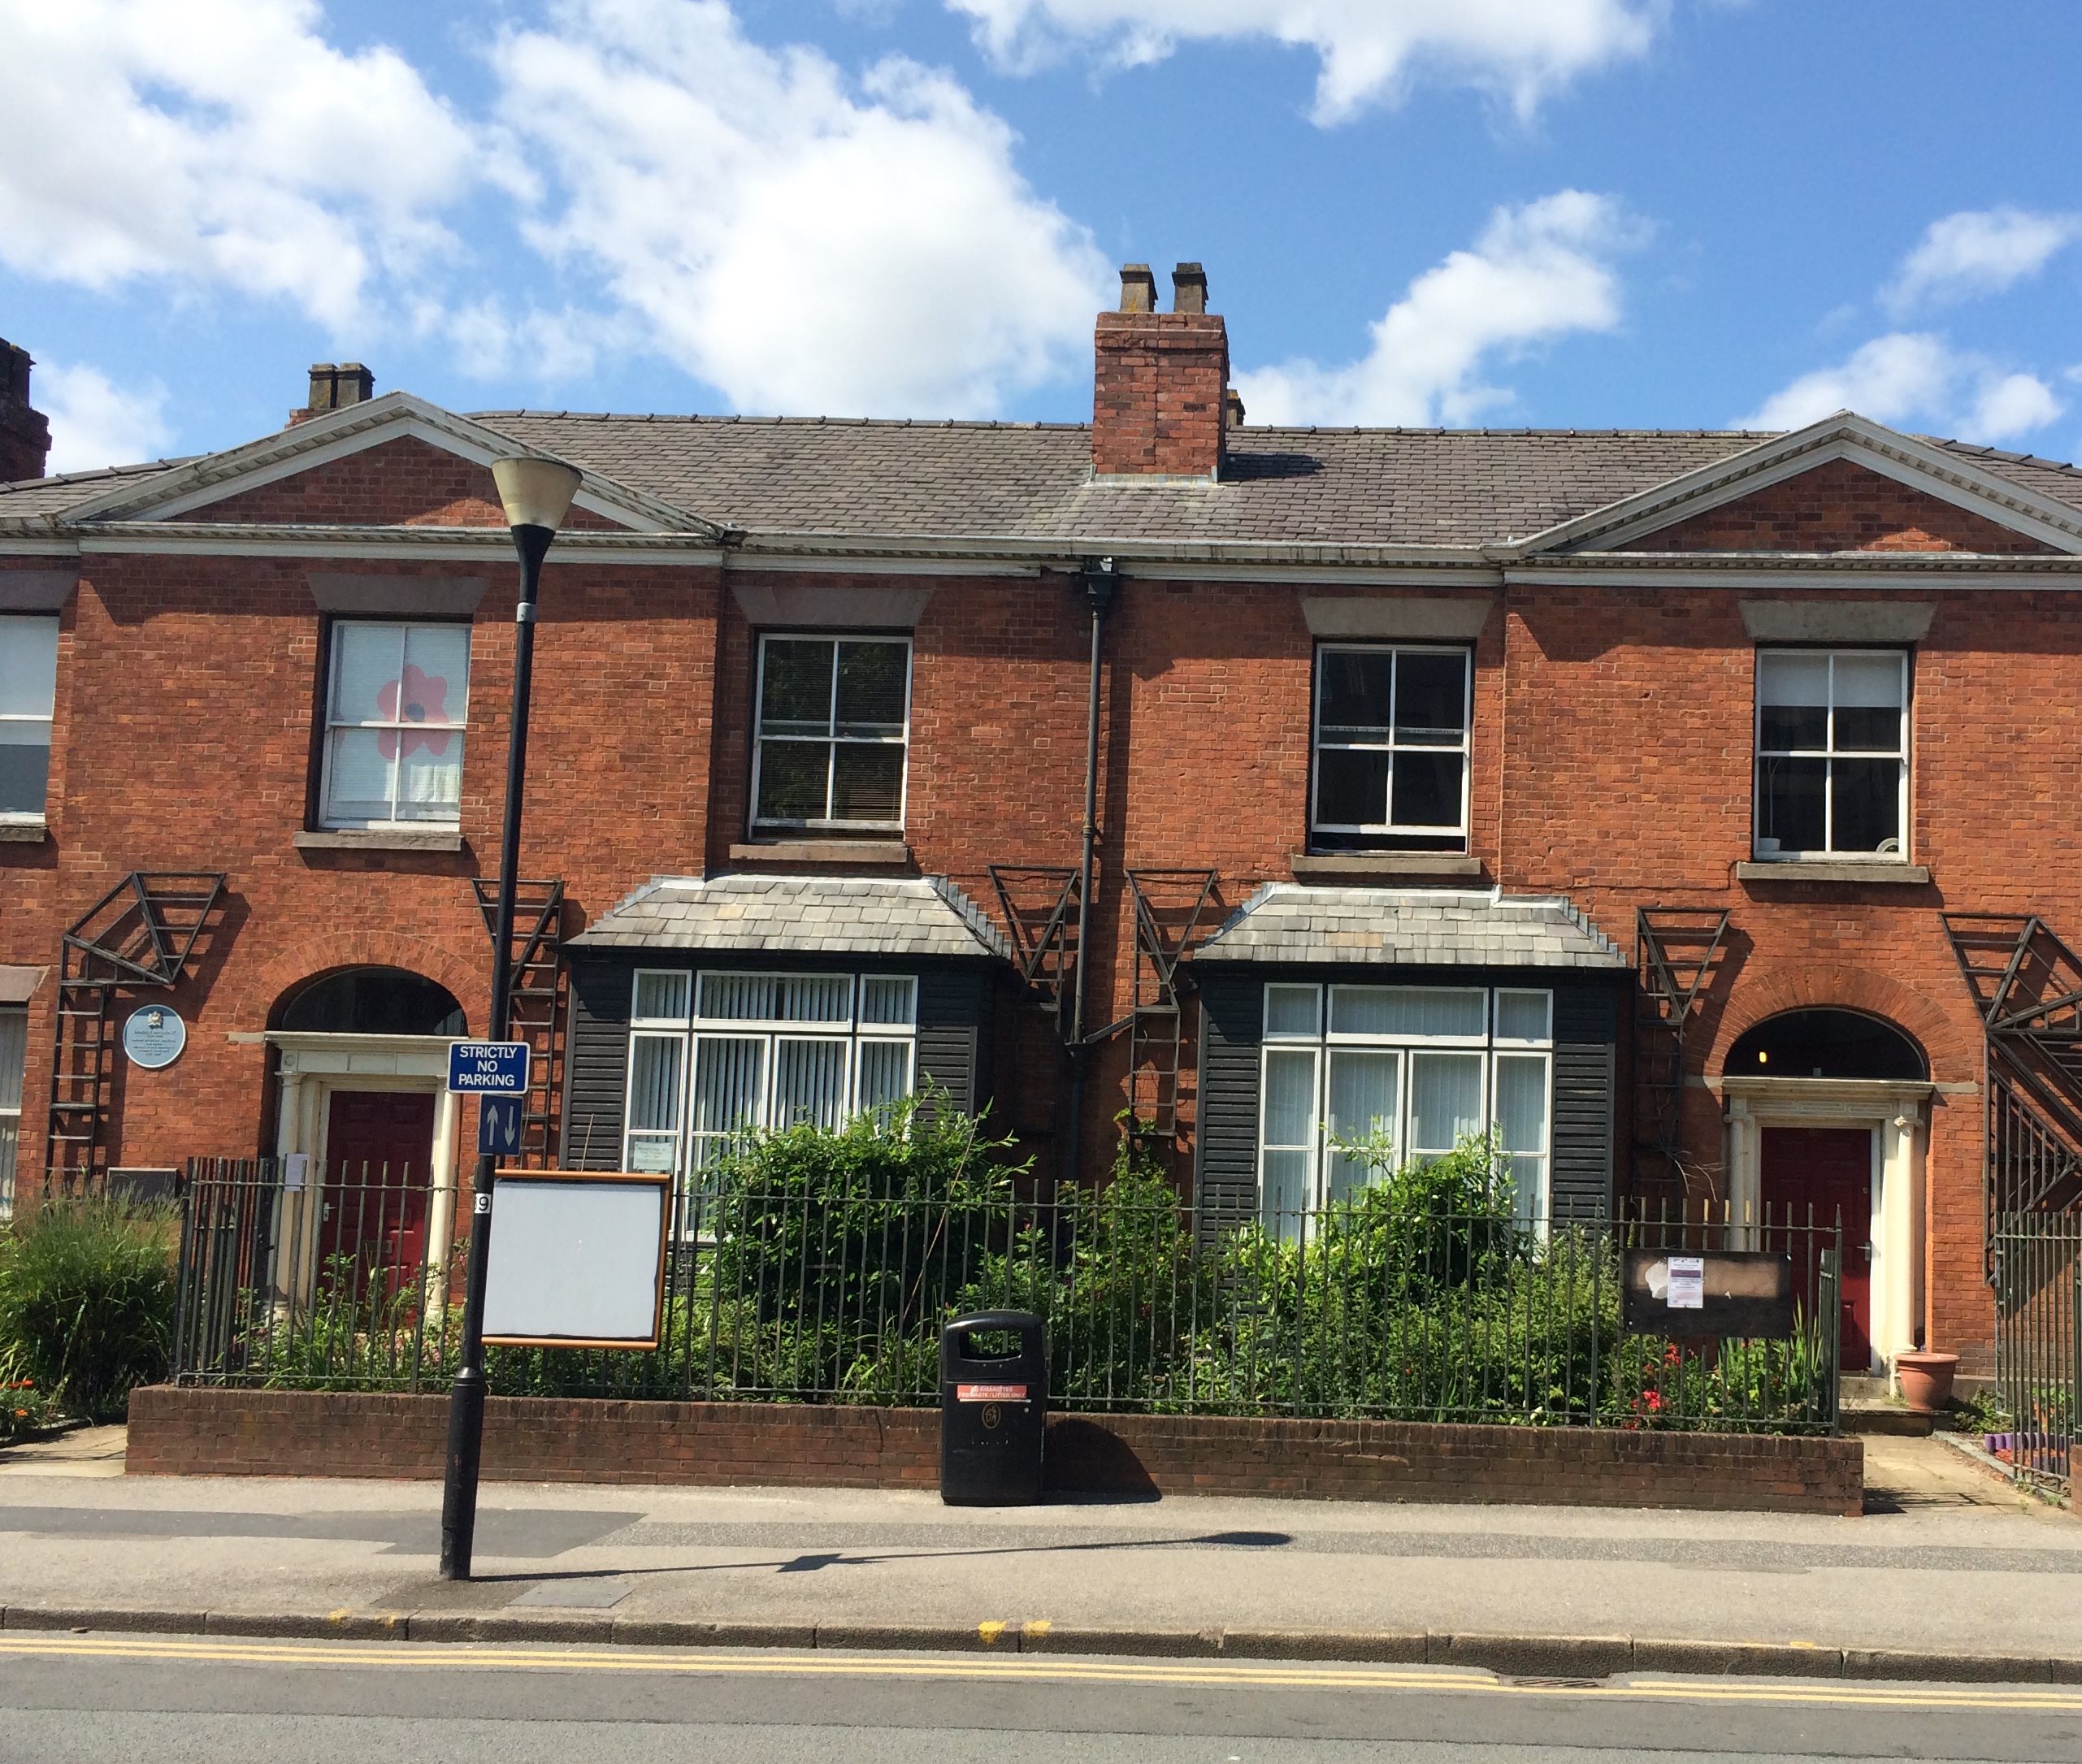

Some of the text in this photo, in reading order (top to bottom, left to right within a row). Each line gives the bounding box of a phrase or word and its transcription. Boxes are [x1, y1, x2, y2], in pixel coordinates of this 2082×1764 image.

[459, 1046, 518, 1059] STRICTLY
[477, 1060, 497, 1073] NO
[458, 1073, 515, 1086] PARKING
[476, 1196, 489, 1211] 9
